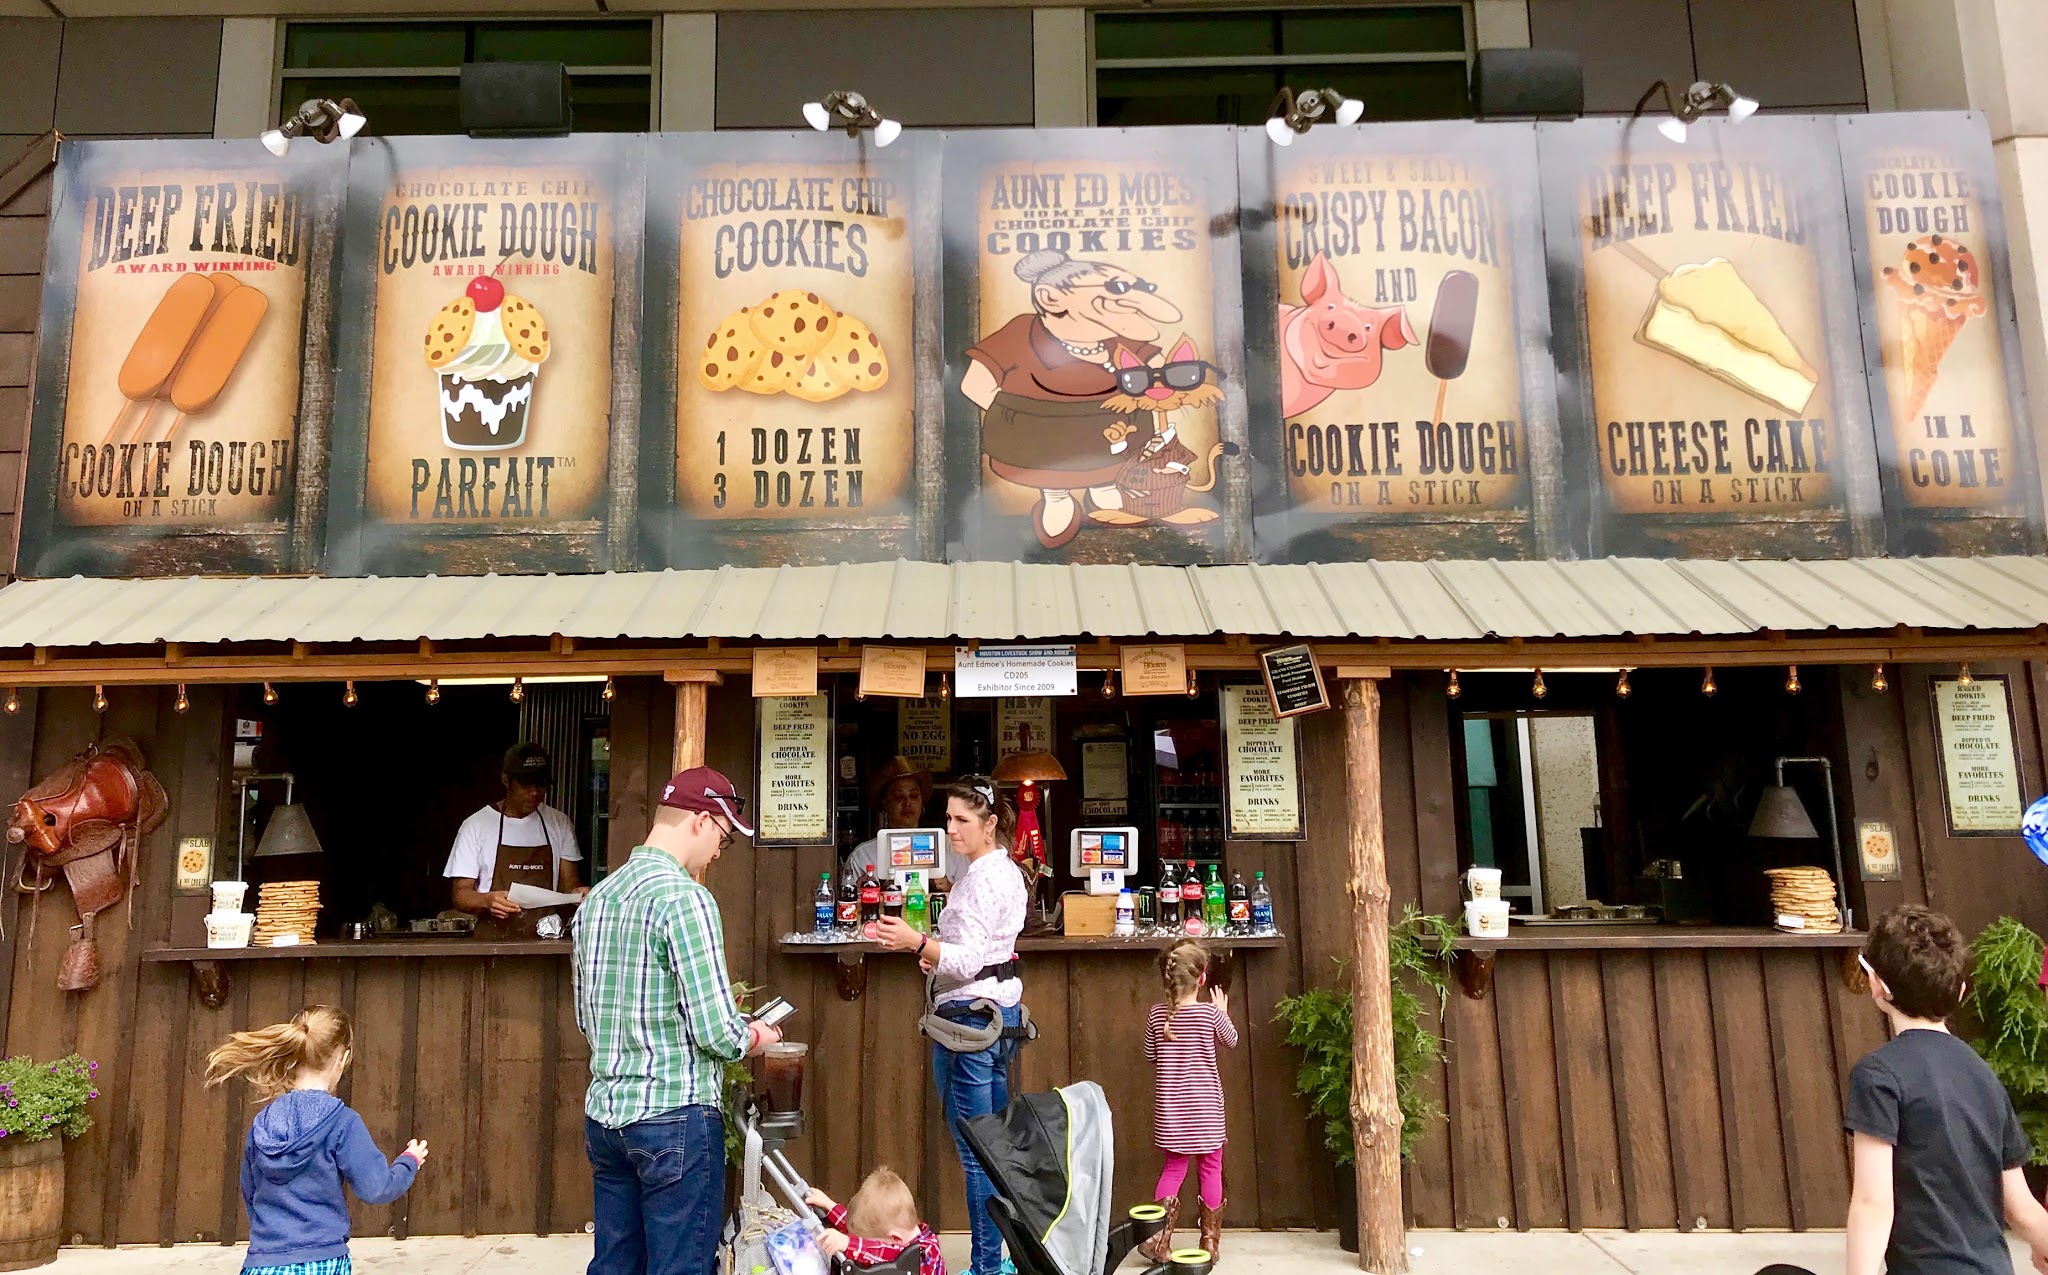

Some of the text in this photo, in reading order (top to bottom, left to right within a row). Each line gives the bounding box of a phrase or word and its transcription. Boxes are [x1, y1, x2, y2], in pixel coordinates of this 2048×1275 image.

[1309, 160, 1374, 185] SWEET
[395, 180, 529, 200] CHOCOLATE
[685, 176, 897, 221] CHOCOLATE CHIP
[991, 173, 1067, 212] AUNT
[1073, 172, 1109, 207] ED
[1869, 172, 1970, 200] COOKIE
[1023, 208, 1162, 218] HOME MADE
[1589, 159, 1807, 251] DEEP FRIED
[88, 181, 301, 272] DEEP FRIED
[993, 216, 1197, 230] CHOCOLATE CHIP
[1284, 187, 1501, 270] CRISPY BACON
[1877, 205, 1970, 235] DOUGH
[382, 201, 598, 275] COOKIE DOUGH
[714, 219, 869, 279] COOKIES
[987, 229, 1198, 255] COOKIES
[114, 261, 277, 274] AWARD WINNING
[432, 263, 560, 277] AWARD WINNING
[1375, 268, 1417, 303] AND
[1924, 415, 1976, 438] IN A
[716, 427, 862, 466] 1 DOZEN
[1289, 420, 1519, 477] COOKIE DOUGH
[1607, 418, 1831, 476] CHEESE CAKE
[62, 439, 291, 499] COOKIE DOUGH
[1909, 448, 2004, 488] CONE
[410, 457, 555, 519] PARFAIT
[713, 470, 864, 509] 3 DOZEN
[1331, 479, 1483, 507] ON A STICK
[1652, 478, 1803, 504] ON A STICK
[122, 498, 218, 517] ON A STICK
[976, 660, 1004, 668] Edmoe's
[1004, 672, 1028, 680] CD205
[978, 683, 1055, 692] Exhibitor Since 2009
[906, 697, 942, 708] NEW
[1004, 698, 1042, 708] NEW
[902, 731, 946, 740] NO EGG
[1954, 742, 2000, 750] CHOCOLATE
[902, 745, 946, 756] EDIBLE
[772, 780, 815, 788] FAVORITES
[1084, 806, 1126, 814] CHOCOLATE
[1248, 798, 1279, 806] DRINKS
[190, 840, 208, 848] SLAB
